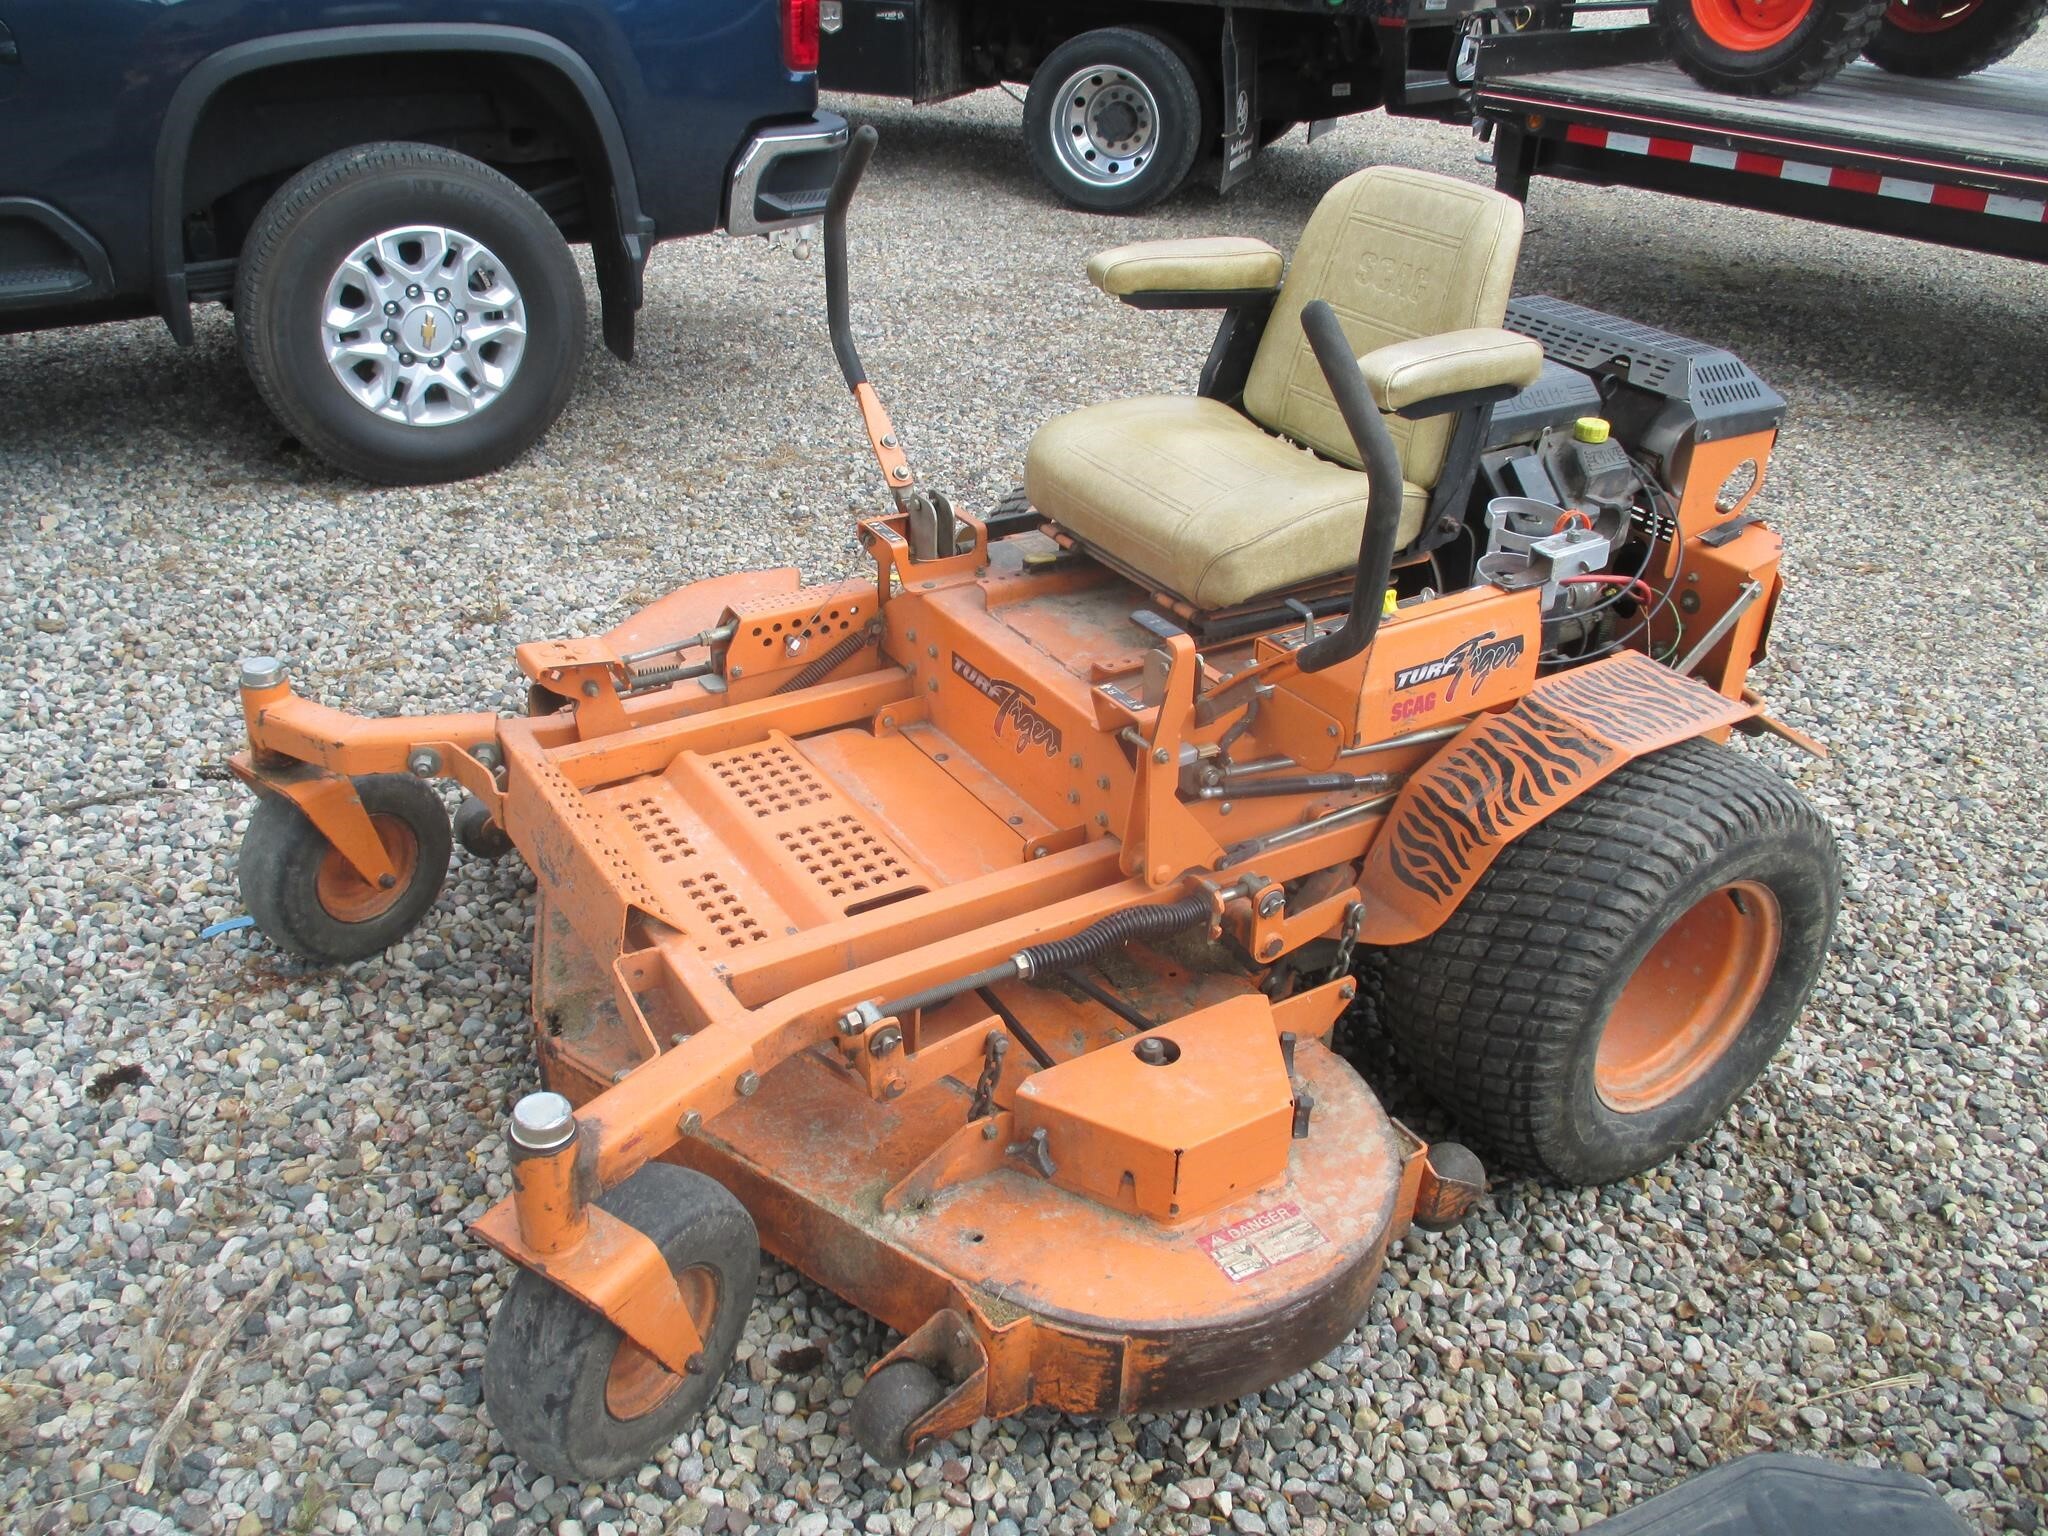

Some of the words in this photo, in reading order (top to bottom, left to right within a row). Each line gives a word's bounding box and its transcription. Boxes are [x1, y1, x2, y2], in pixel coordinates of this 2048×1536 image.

[1397, 656, 1459, 690] TURF
[1444, 631, 1521, 703] Tiger
[953, 656, 1001, 700] TURF
[993, 678, 1058, 758] Tiger
[1391, 691, 1437, 722] SCAG
[1227, 1207, 1291, 1239] DANGER
